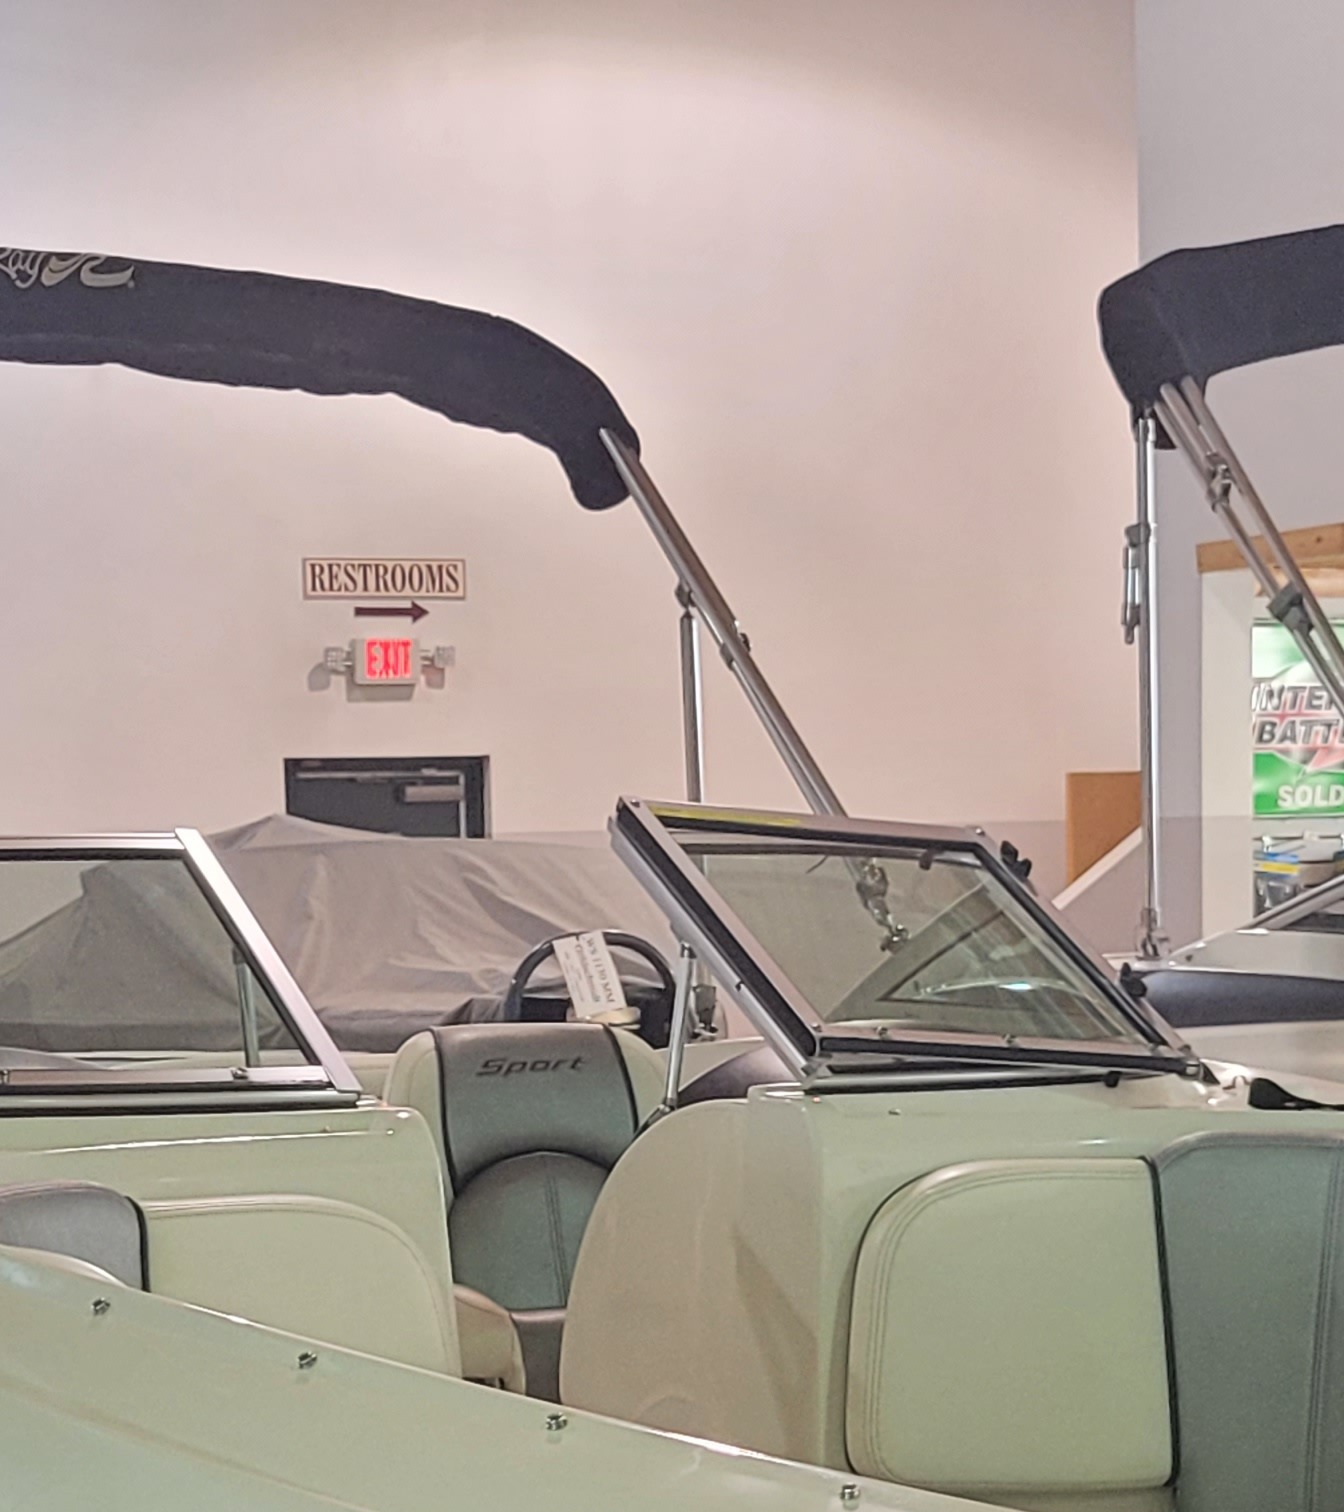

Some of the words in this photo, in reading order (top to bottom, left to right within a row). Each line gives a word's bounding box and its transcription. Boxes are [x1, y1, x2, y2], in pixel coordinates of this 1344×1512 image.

[309, 563, 460, 593] RESTROOMS
[365, 639, 413, 678] EXIT
[476, 1055, 587, 1079] Sport
